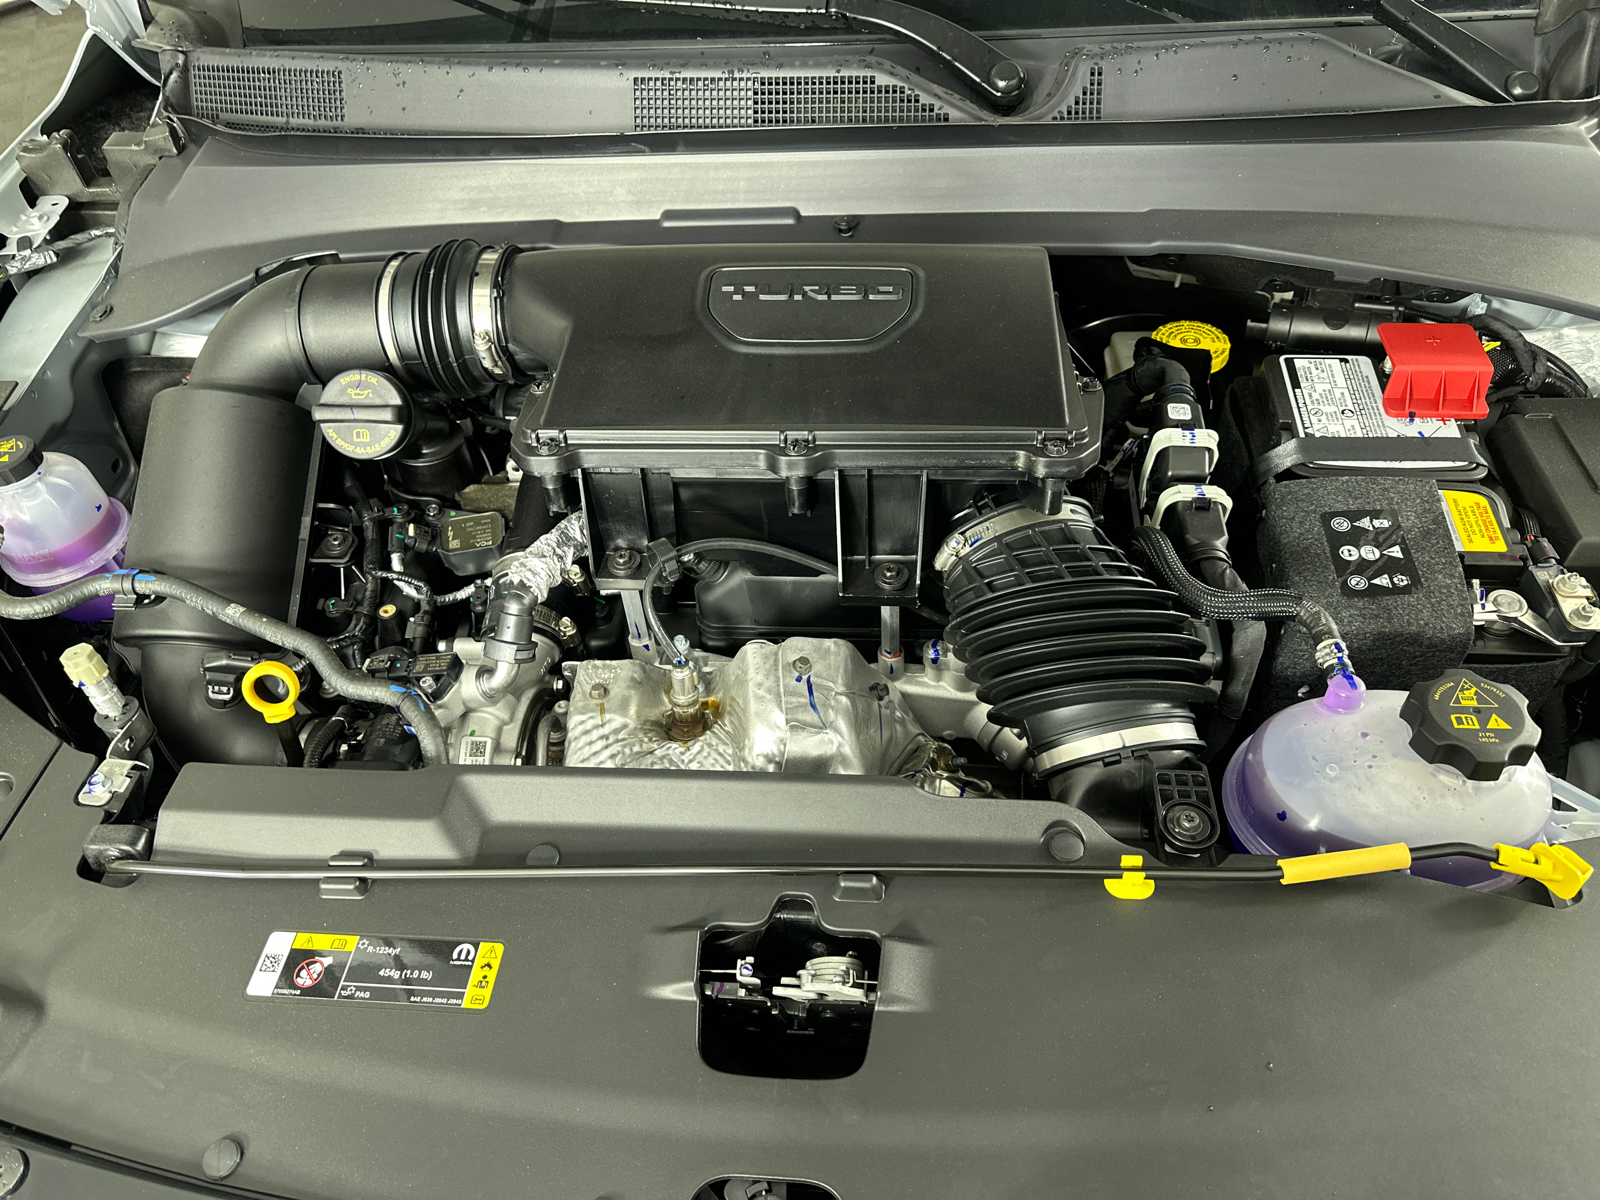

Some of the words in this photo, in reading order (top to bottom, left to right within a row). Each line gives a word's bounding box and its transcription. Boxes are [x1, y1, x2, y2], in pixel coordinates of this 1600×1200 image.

[721, 283, 903, 301] TURBO
[340, 374, 367, 385] ENGINE
[367, 376, 378, 385] OIL
[327, 429, 338, 440] API
[1452, 498, 1463, 517] BATTERY
[367, 946, 401, 956] R-1234yf
[378, 968, 400, 979] 454g
[402, 969, 419, 980] (1.0
[420, 970, 433, 981] lb)
